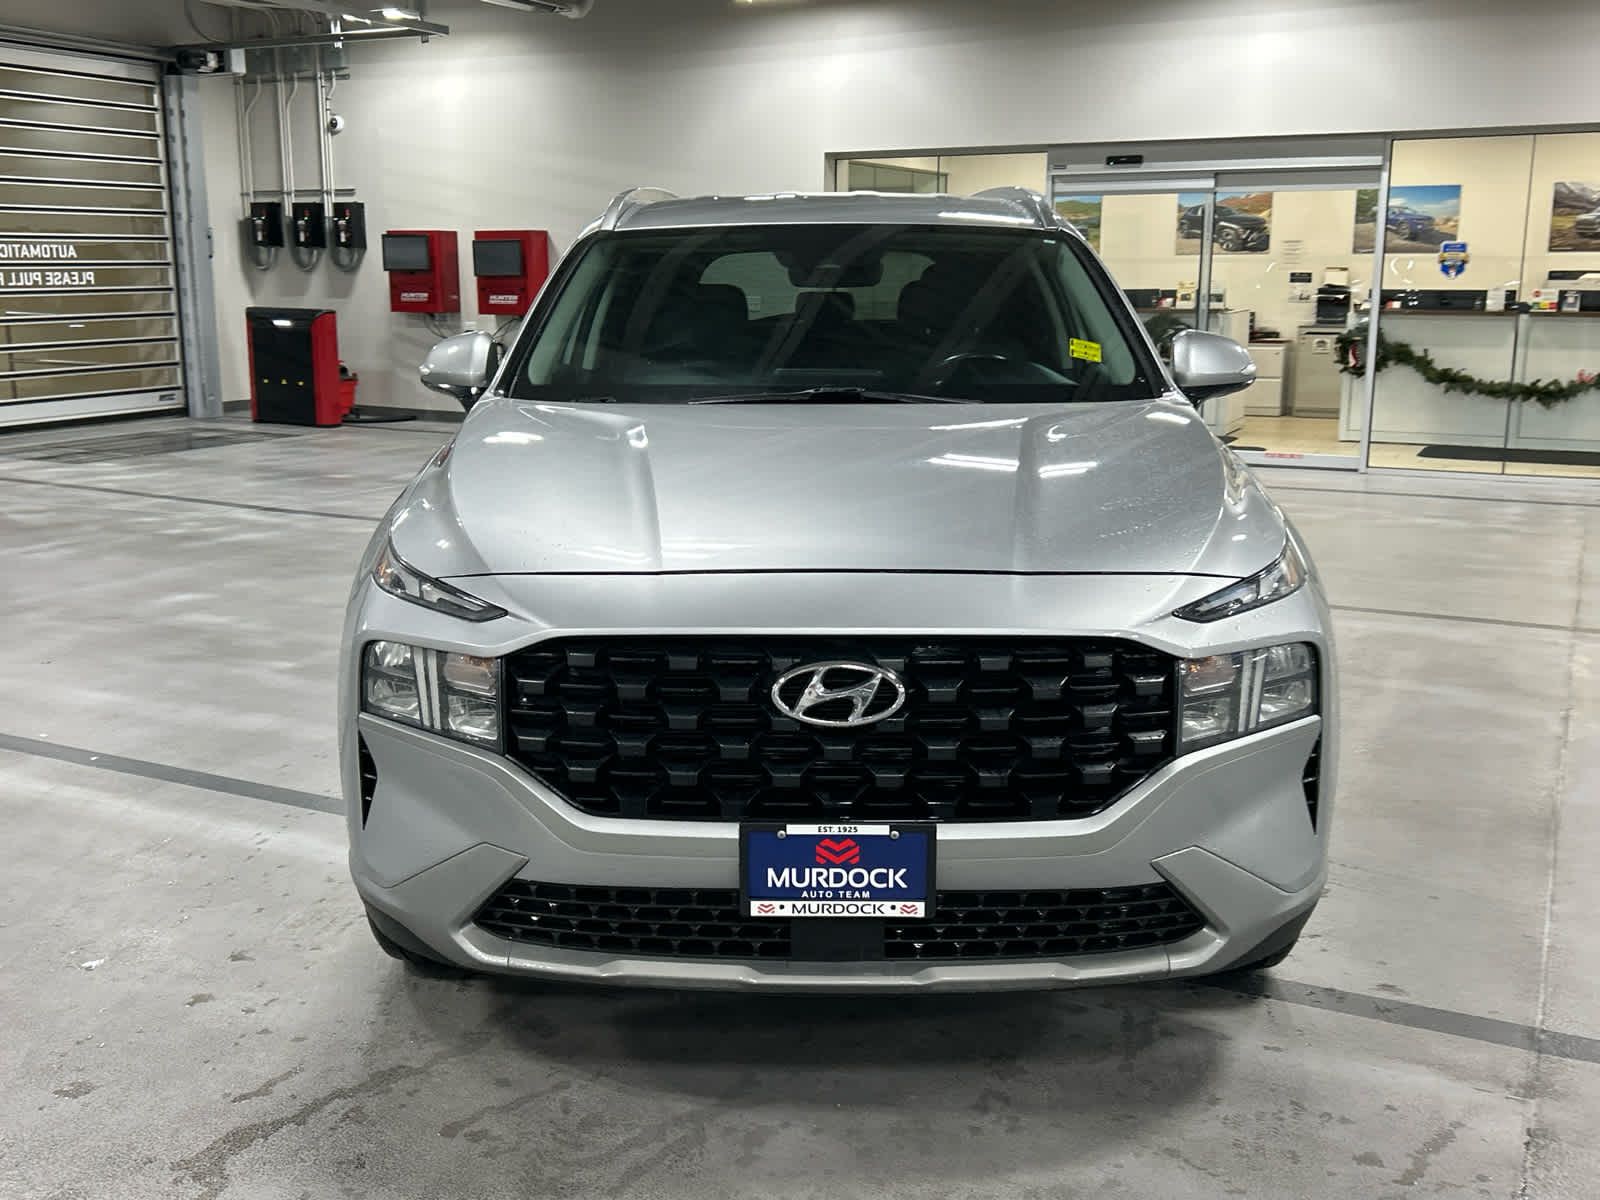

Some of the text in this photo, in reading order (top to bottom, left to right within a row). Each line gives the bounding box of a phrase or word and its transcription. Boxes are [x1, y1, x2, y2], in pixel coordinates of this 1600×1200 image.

[767, 867, 907, 888] MURDOCK
[801, 890, 870, 899] AUTO TEAM
[792, 903, 885, 914] MURDOCK
